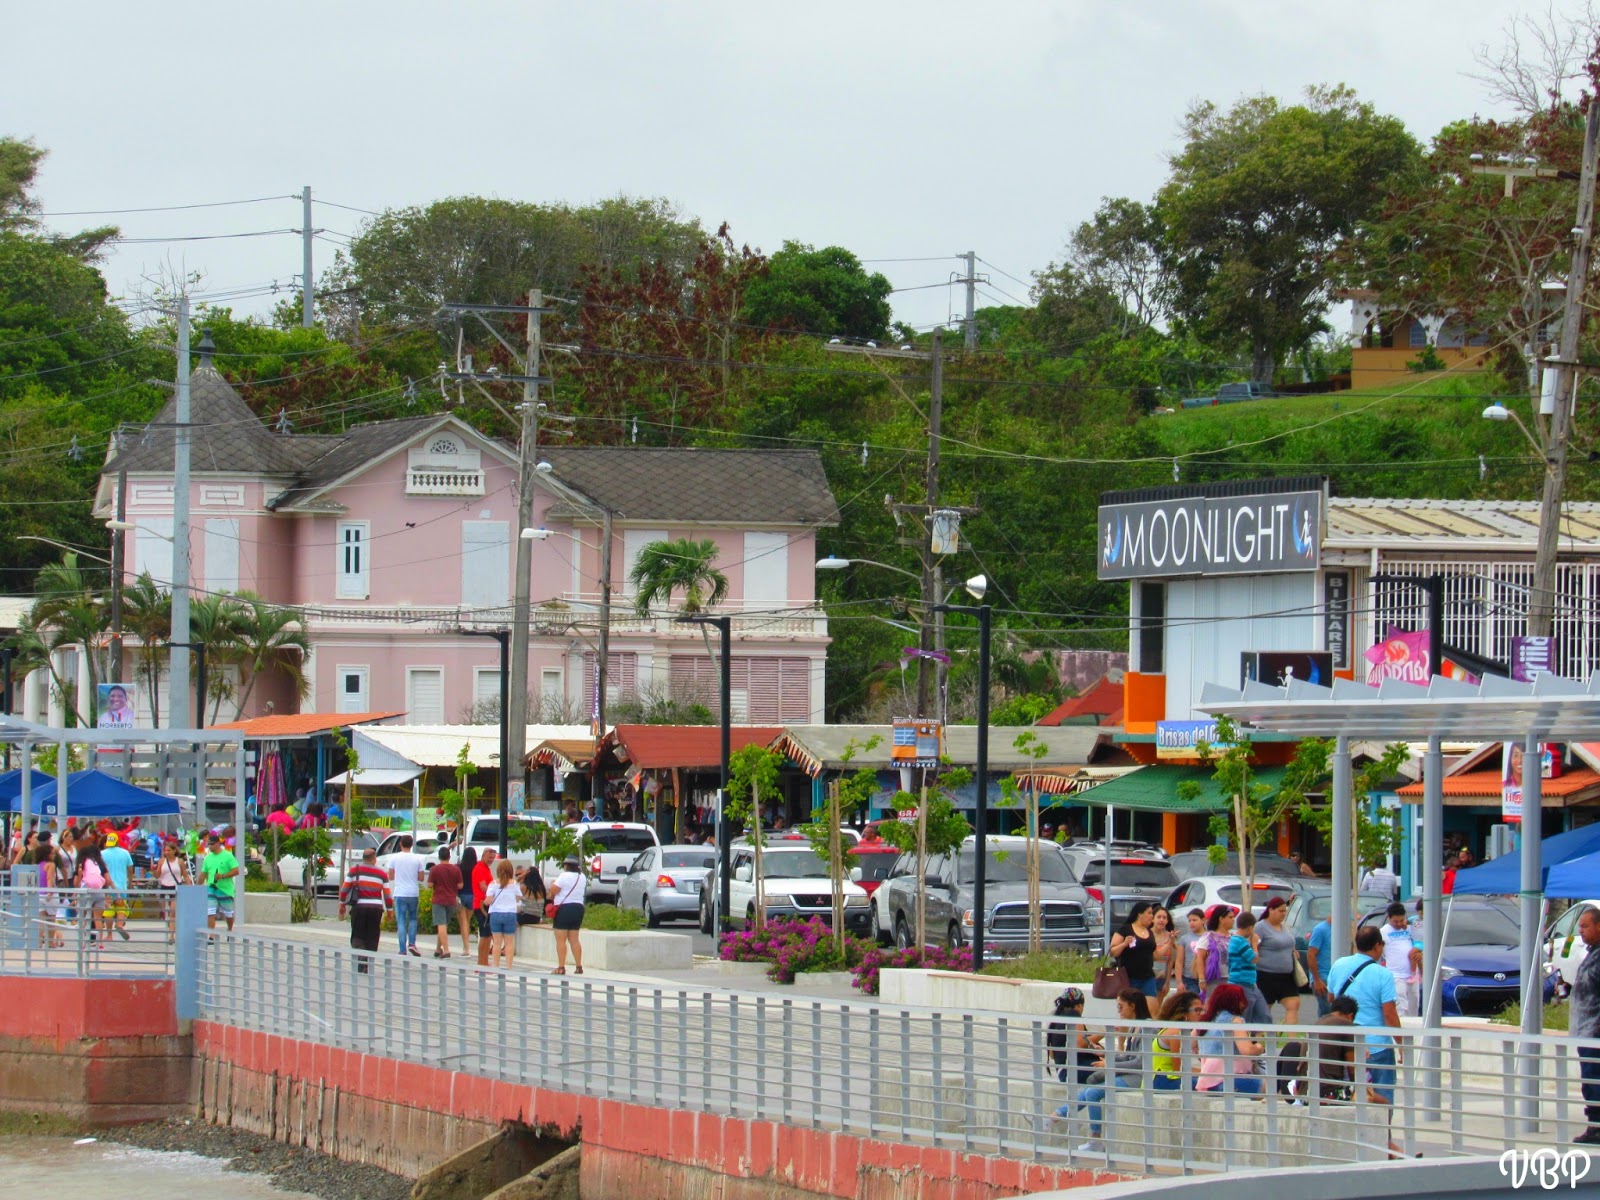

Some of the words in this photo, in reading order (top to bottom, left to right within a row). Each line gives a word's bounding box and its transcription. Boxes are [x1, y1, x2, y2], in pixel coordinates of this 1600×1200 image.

[1122, 504, 1289, 567] MOONLIGHT
[1328, 578, 1343, 663] BILLARES
[1158, 726, 1190, 747] Brisas
[1192, 724, 1208, 745] del
